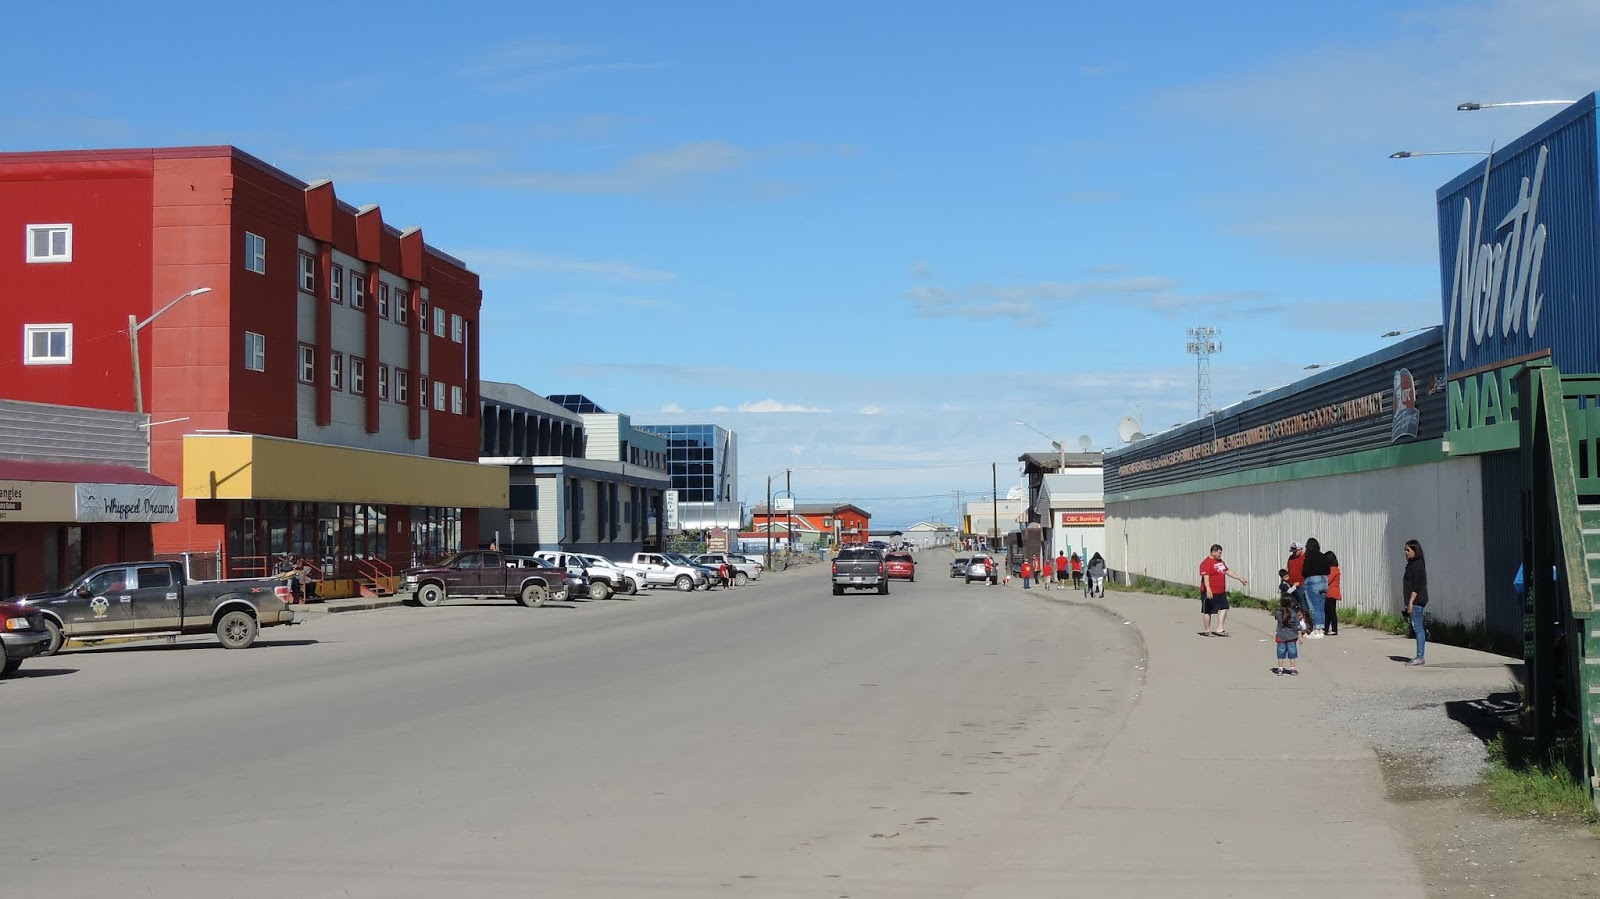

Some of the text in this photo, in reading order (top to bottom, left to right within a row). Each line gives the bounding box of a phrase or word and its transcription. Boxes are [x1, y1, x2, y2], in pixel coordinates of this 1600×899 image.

[1447, 139, 1548, 367] North
[1274, 412, 1308, 439] SPORTING
[1308, 404, 1337, 431] GOODS
[1342, 391, 1384, 422] PHARMACY
[103, 498, 174, 519] Whipped Dreams
